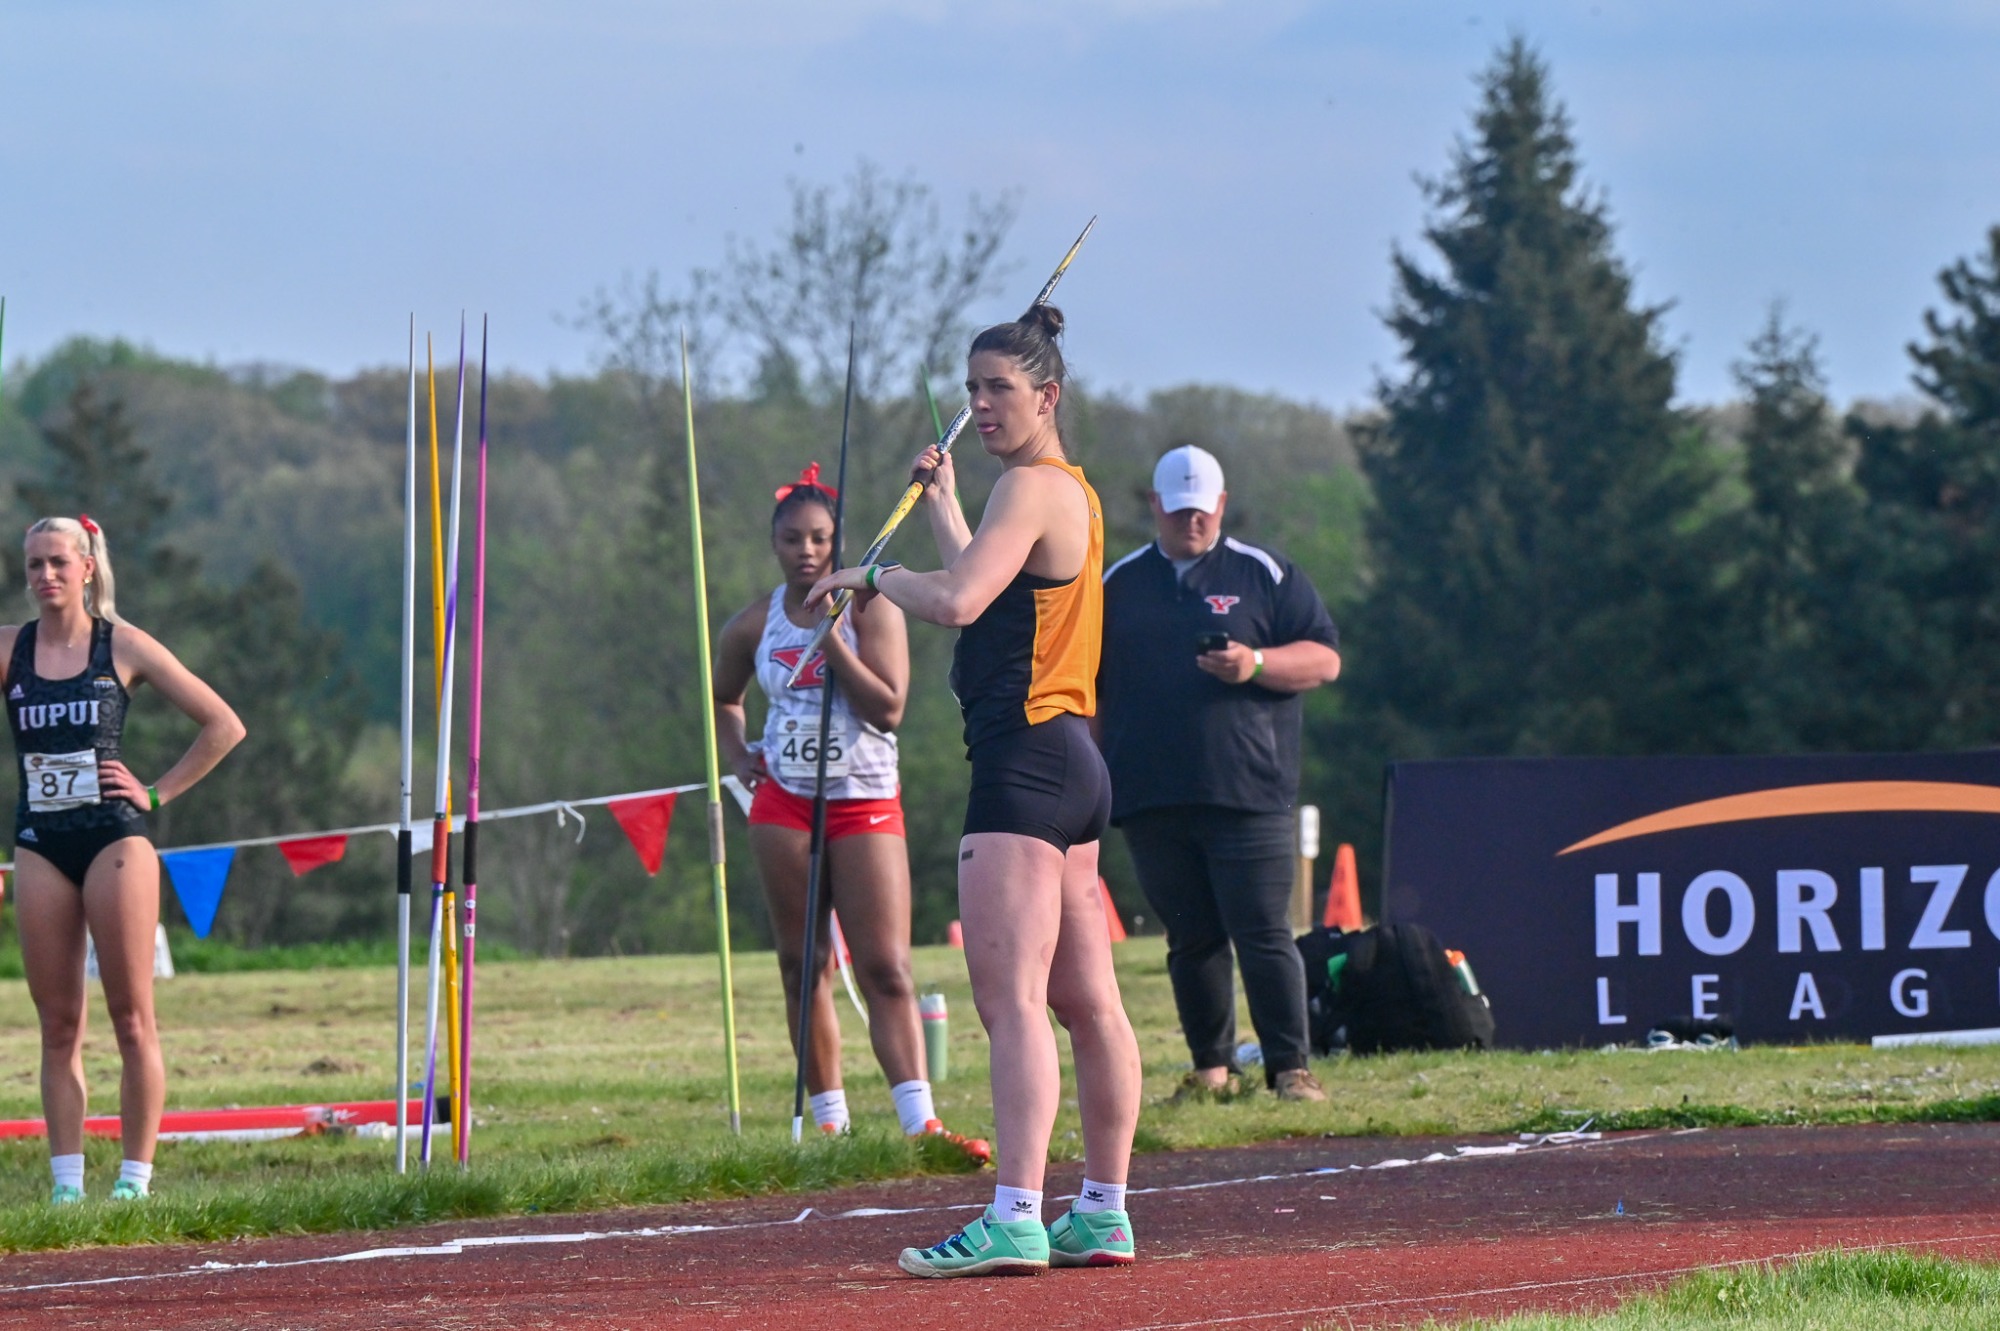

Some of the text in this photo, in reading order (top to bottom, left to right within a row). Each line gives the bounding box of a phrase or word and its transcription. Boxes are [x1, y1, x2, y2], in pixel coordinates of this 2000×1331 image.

[1204, 595, 1240, 614] Y
[18, 700, 100, 731] IUPUI
[782, 737, 843, 762] 466
[41, 770, 79, 798] 87
[1595, 864, 2000, 957] HORIZ
[1597, 967, 2000, 1025] LEAG
